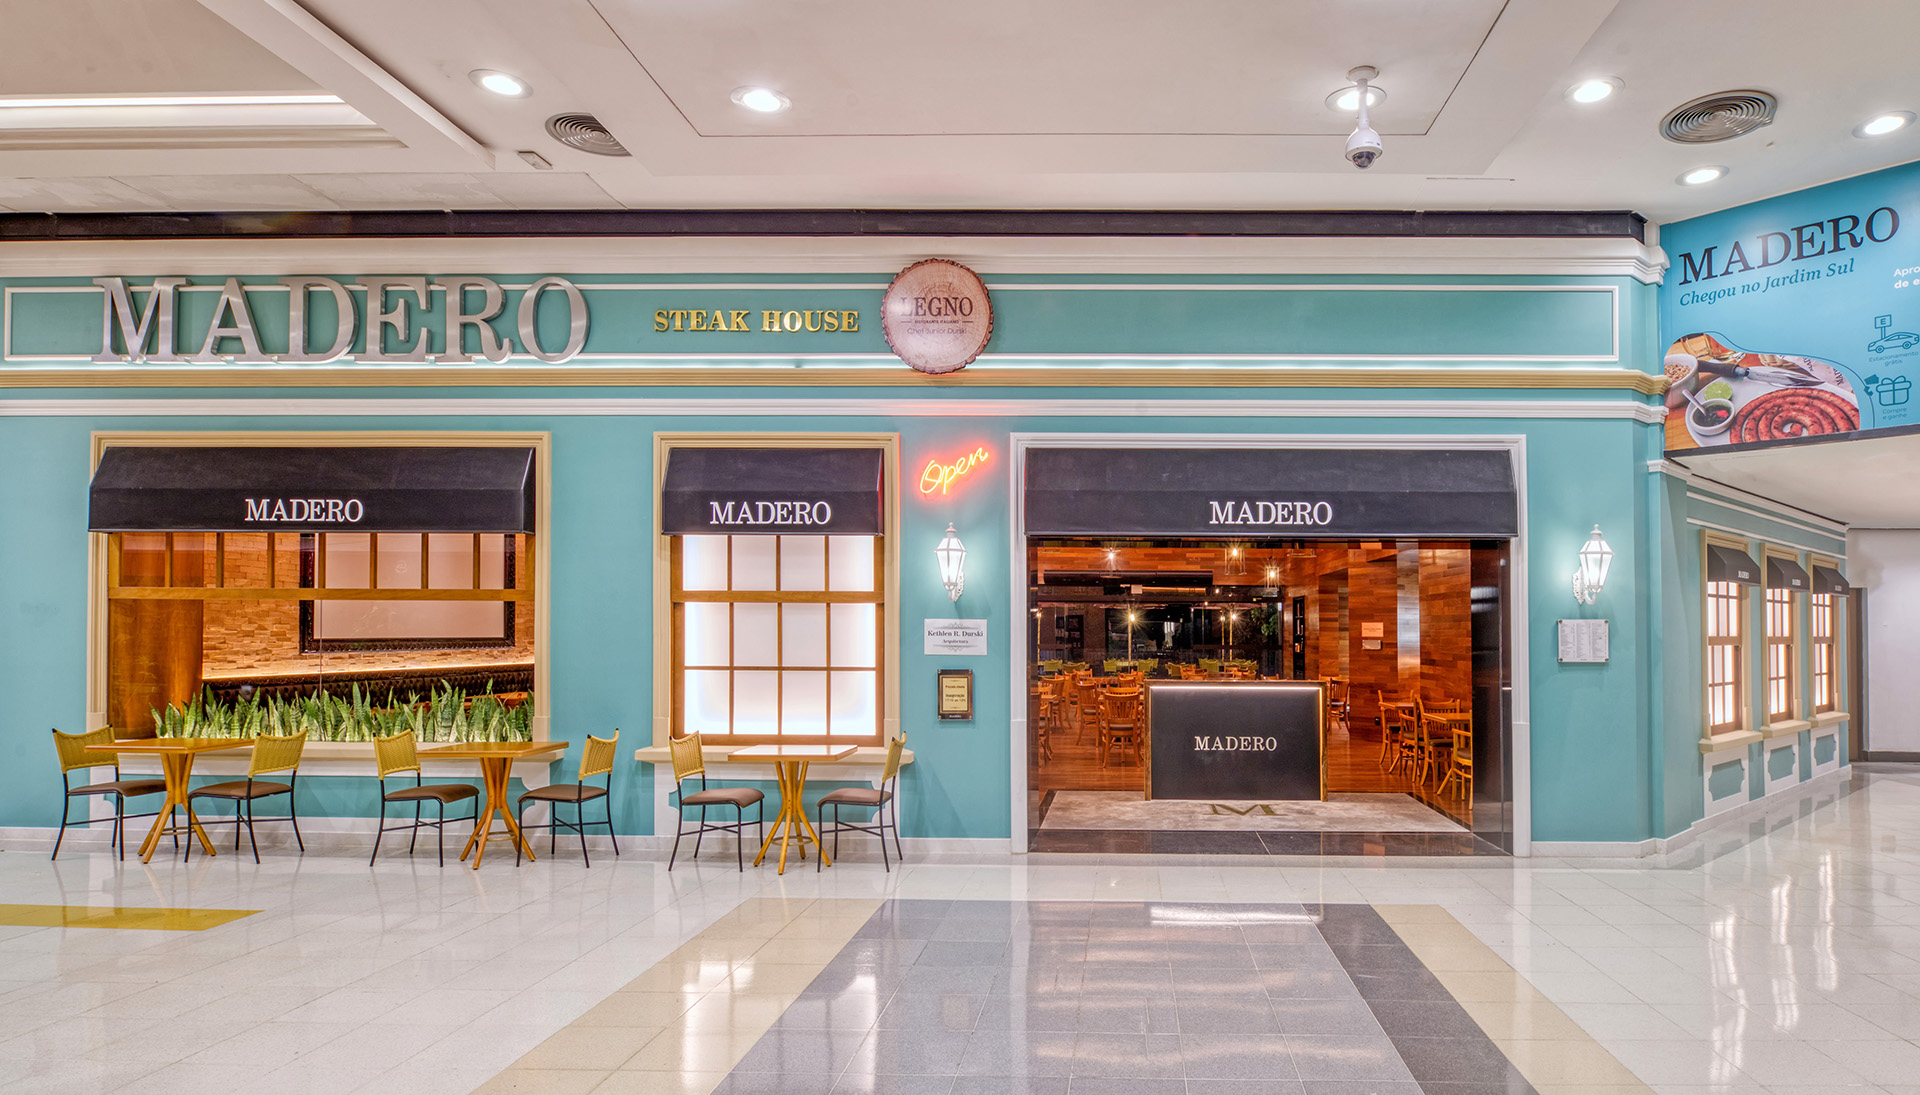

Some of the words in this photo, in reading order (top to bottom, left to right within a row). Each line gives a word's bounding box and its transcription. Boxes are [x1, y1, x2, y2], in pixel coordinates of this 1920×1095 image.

[1678, 207, 1900, 286] MADERO
[1680, 285, 1737, 306] Chegou
[1741, 281, 1760, 293] no
[1763, 269, 1821, 292] Jardim
[1826, 258, 1855, 277] Sul
[1894, 280, 1909, 289] de
[901, 297, 973, 316] LEGNO
[92, 276, 589, 364] MADERO
[654, 309, 750, 332] STEAK
[762, 310, 859, 333] HOUSE
[907, 327, 924, 335] Chef
[1869, 351, 1919, 362] Estacionamento
[1884, 358, 1903, 367] grátis
[919, 446, 989, 495] Open
[244, 498, 364, 522] MADERO
[709, 501, 832, 525] MADERO
[1209, 501, 1333, 525] MADERO
[1194, 735, 1278, 752] MADERO
